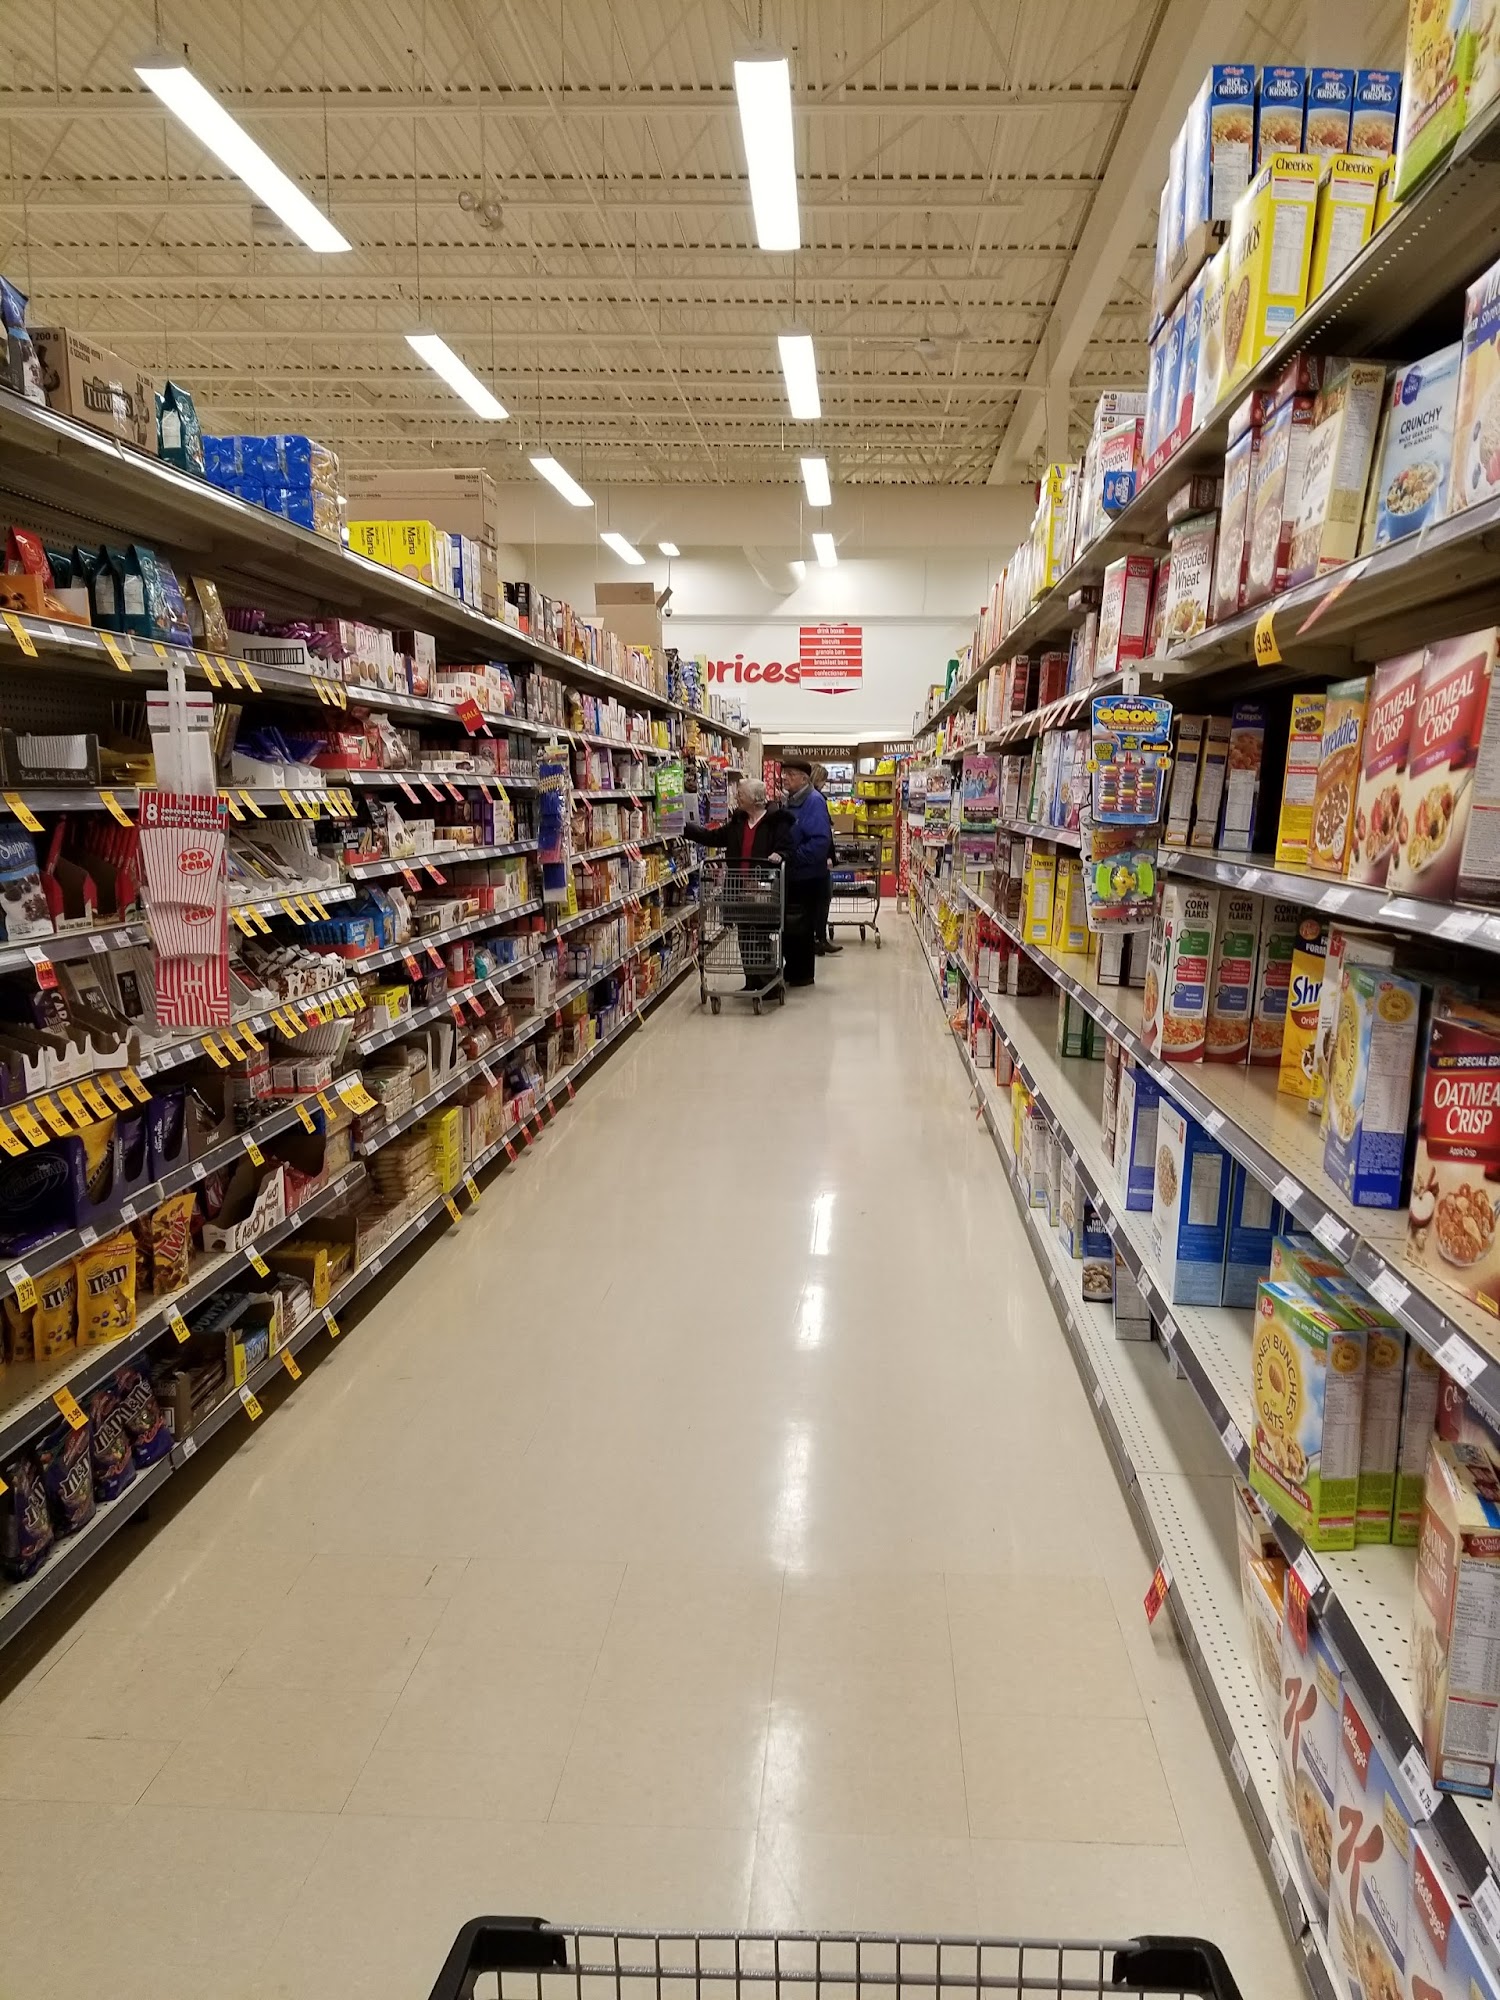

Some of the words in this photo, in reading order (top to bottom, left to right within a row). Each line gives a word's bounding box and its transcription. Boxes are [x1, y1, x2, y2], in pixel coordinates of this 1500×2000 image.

[1227, 78, 1240, 86] RICE
[1277, 80, 1291, 89] RICE
[1325, 82, 1339, 91] RICE
[1371, 83, 1385, 92] RICE
[1219, 84, 1248, 95] KRISPIES
[1269, 87, 1297, 97] KRISPIES
[1317, 89, 1346, 100] KRISPIES
[1363, 89, 1392, 101] KRISPIES
[1276, 158, 1313, 172] Cheerios
[1337, 160, 1374, 175] Cheerios
[1212, 220, 1226, 245] 4
[1400, 406, 1442, 434] CRUNCHY
[366, 527, 374, 555] Maria
[407, 527, 415, 555] Maria
[1172, 546, 1208, 575] Shredded
[1175, 570, 1200, 591] Wheat
[1257, 631, 1273, 653] 3.99
[1418, 670, 1475, 728] OATMEAL
[1371, 684, 1417, 736] OATMEAL
[462, 711, 480, 722] SALE
[1236, 712, 1263, 722] Crispix
[1423, 704, 1460, 747] CRISP
[1376, 714, 1405, 752] CRISP
[798, 748, 851, 756] APPETIZERS
[884, 744, 914, 753] HAMBUR
[146, 803, 158, 821] 8
[181, 851, 204, 861] POP
[181, 859, 211, 871] CORN
[1185, 900, 1209, 910] CORN
[1229, 902, 1253, 912] CORN
[1274, 904, 1299, 915] CORN
[1184, 909, 1208, 919] FLAKES
[1228, 911, 1253, 921] FLAKES
[37, 961, 52, 972] SALE
[1291, 975, 1322, 1007] Shr
[1437, 1057, 1456, 1066] NEW!
[1457, 1056, 1487, 1067] SPECIAL
[133, 1085, 146, 1096] 1.99
[1434, 1078, 1500, 1109] OATMEA
[113, 1094, 125, 1104] 1.99
[93, 1101, 106, 1112] 1.99
[73, 1109, 87, 1120] 1.99
[1446, 1106, 1493, 1135] CRISP
[51, 1117, 66, 1129] 1.99
[28, 1126, 42, 1138] 1.99
[2, 1137, 19, 1149] 1.99
[1449, 1147, 1464, 1157] Apple
[1464, 1148, 1477, 1158] Crisp
[17, 1283, 33, 1293] FINAL
[21, 1289, 34, 1302] 3.74
[1261, 1300, 1273, 1315] Post
[1257, 1334, 1271, 1391] HONEY
[1273, 1334, 1297, 1421] BUNCHES
[68, 1408, 82, 1423] 3.99
[1263, 1401, 1284, 1430] OATS
[1289, 1574, 1306, 1613] SALE
[1343, 1716, 1367, 1768] Kellogg's
[1307, 1730, 1328, 1777] Original
[1419, 1788, 1432, 1809] 4.79
[1370, 1875, 1399, 1938] Original
[1415, 1872, 1446, 1941] Kellogg's
